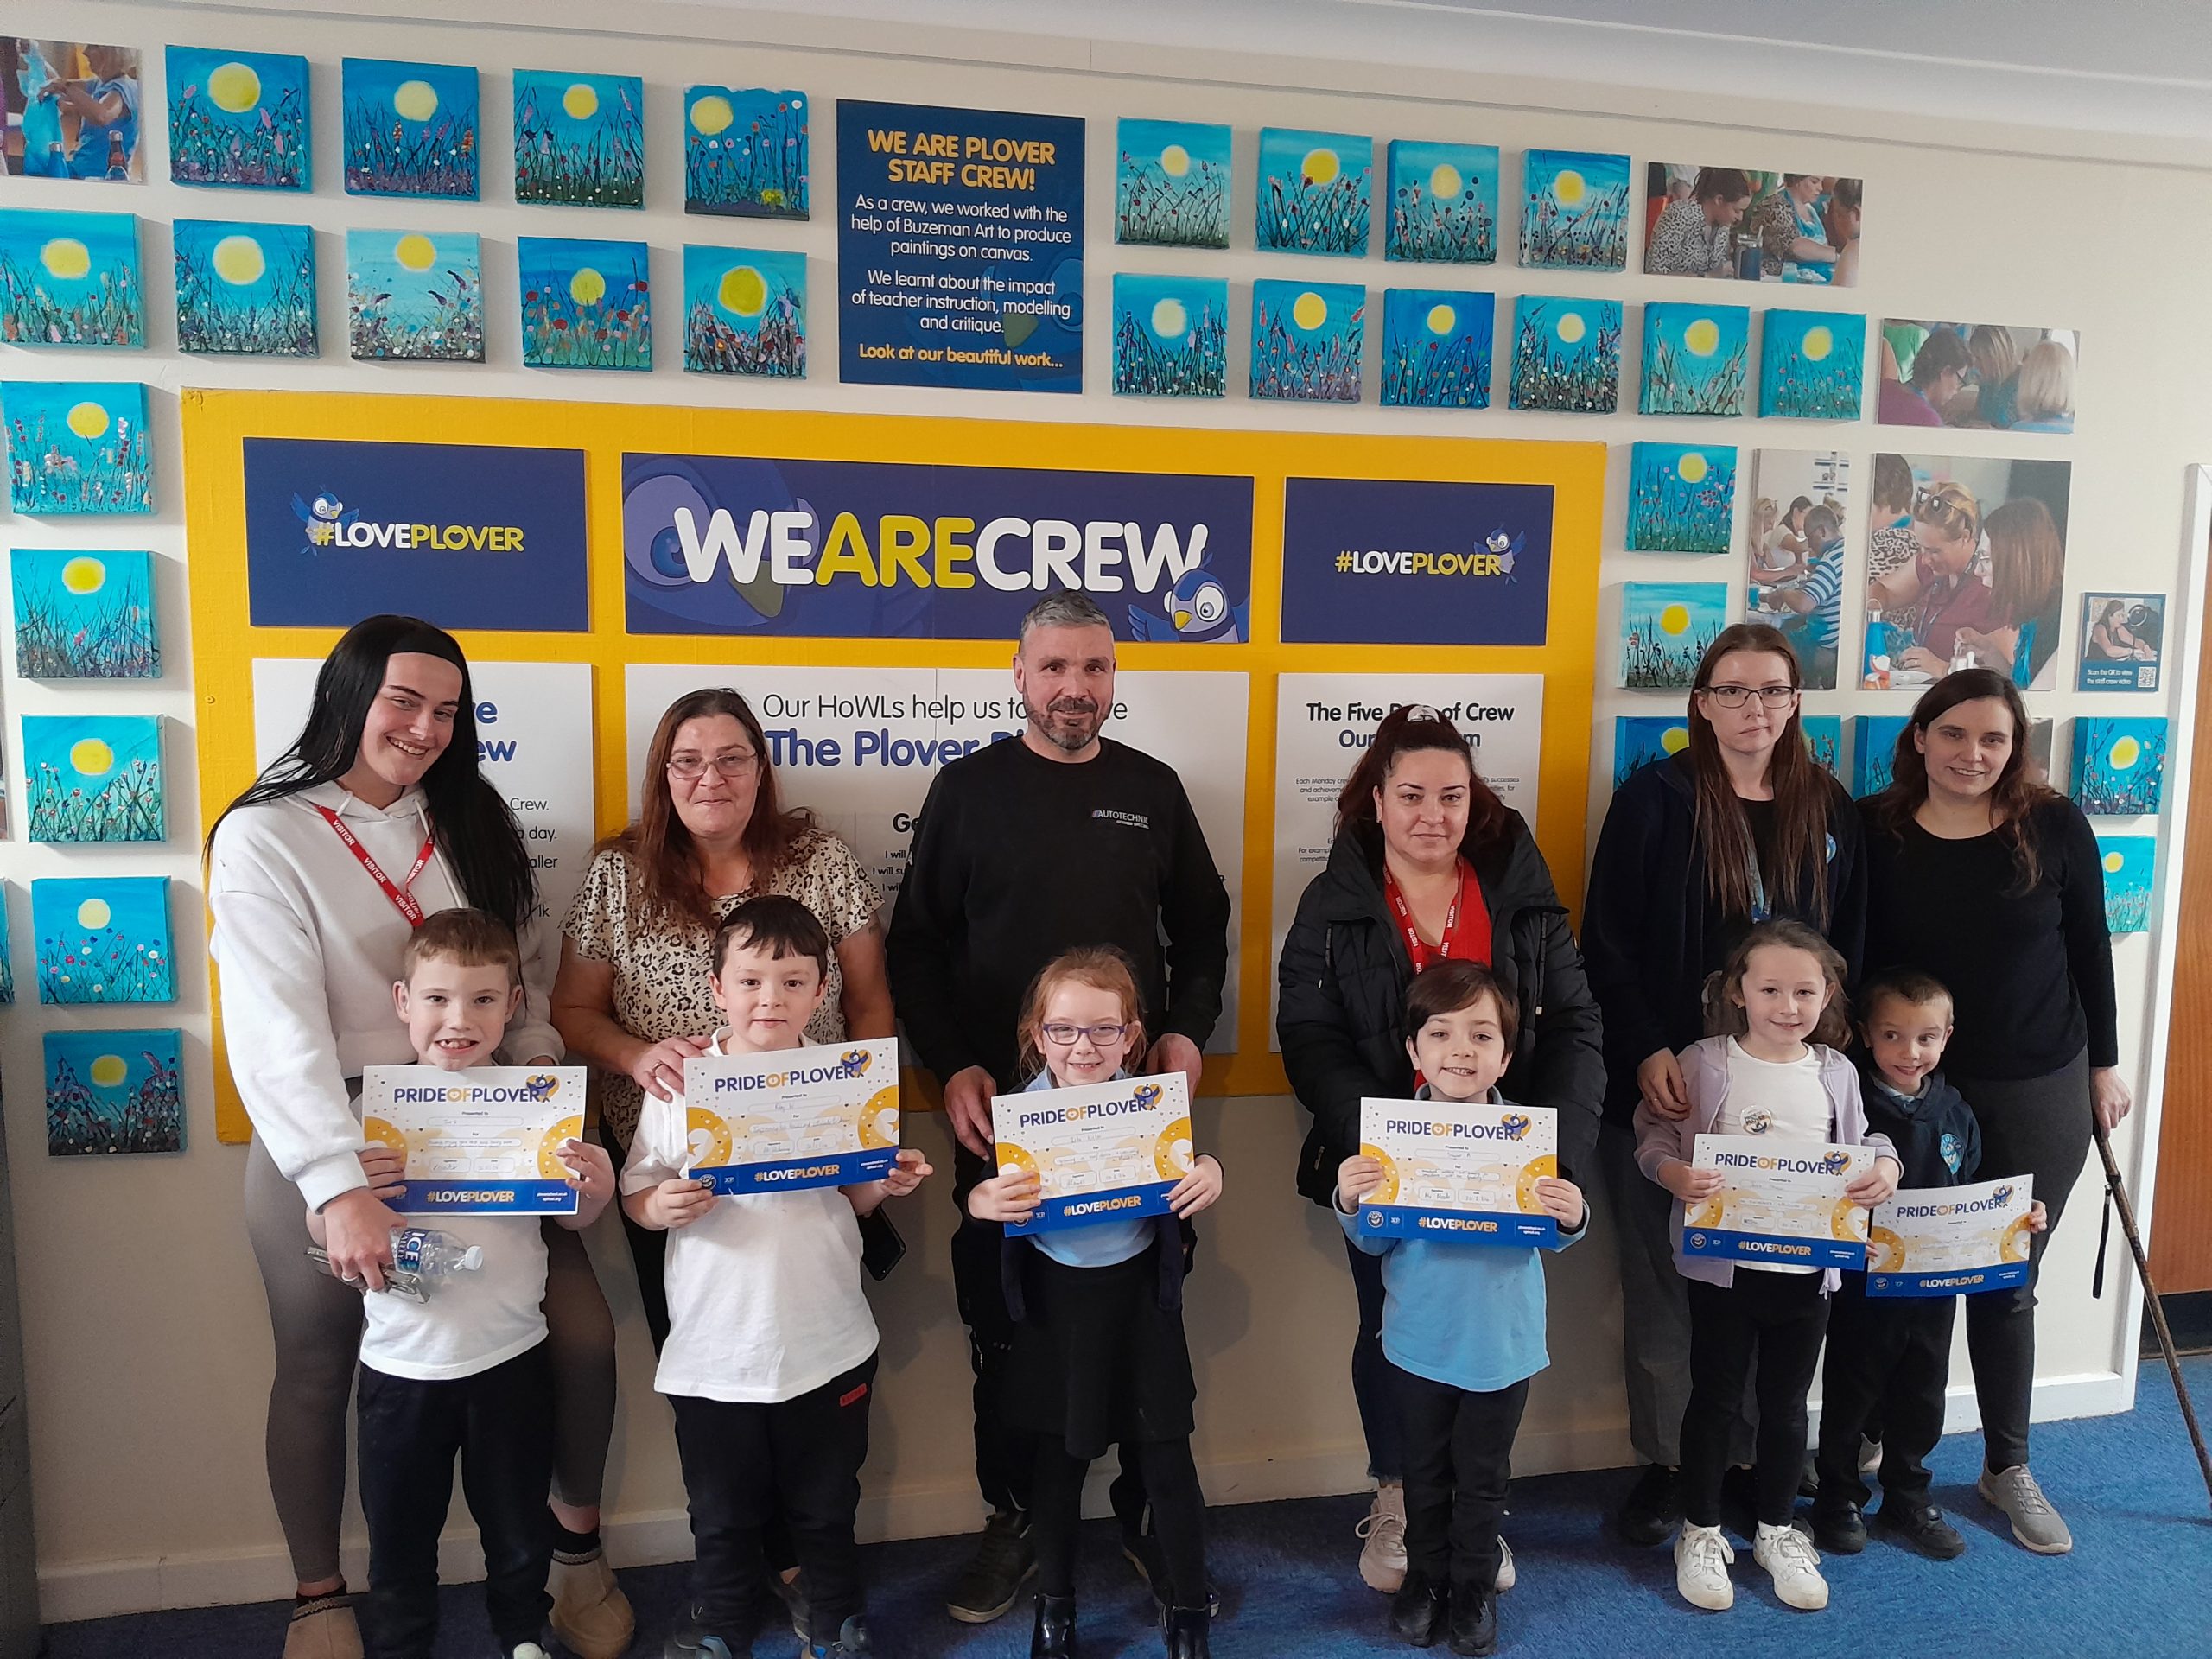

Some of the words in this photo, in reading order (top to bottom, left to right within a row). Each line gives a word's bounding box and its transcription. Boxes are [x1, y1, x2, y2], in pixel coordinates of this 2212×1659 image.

[868, 130, 906, 154] WE
[912, 132, 958, 157] ARE
[965, 137, 1056, 165] PLOVER
[888, 160, 955, 185] STAFF
[961, 165, 1036, 191] CREW!
[855, 194, 874, 209] As
[878, 199, 887, 210] a
[891, 200, 928, 215] crew,
[931, 202, 953, 214] we
[957, 202, 1010, 219] worked
[1013, 206, 1042, 221] with
[1046, 207, 1067, 222] the
[851, 214, 882, 233] help
[886, 217, 900, 232] of
[903, 219, 969, 238] Buzeman
[974, 224, 995, 238] Art
[997, 226, 1010, 239] to
[1014, 226, 1071, 244] produce
[891, 240, 956, 259] paintings
[959, 246, 977, 258] on
[980, 247, 1033, 262] canvas.
[868, 270, 892, 285] We
[895, 271, 935, 288] learnt
[938, 273, 980, 291] about
[982, 276, 1005, 292] the
[1008, 278, 1055, 296] impact
[851, 289, 866, 304] of
[868, 290, 923, 308] teacher
[925, 295, 999, 315] instruction,
[1002, 300, 1071, 319] modelling
[920, 315, 949, 330] and
[951, 317, 1005, 335] critique.
[859, 343, 895, 360] Look
[898, 346, 914, 360] at
[918, 349, 944, 363] our
[946, 346, 1012, 365] beautiful
[1014, 353, 1064, 368] work...
[763, 694, 810, 718] Our
[818, 694, 905, 719] HoWLs
[912, 694, 965, 725] help
[973, 701, 1001, 719] us
[1306, 702, 1342, 721] The
[1347, 702, 1383, 721] Five
[1442, 702, 1461, 721] of
[1466, 703, 1515, 721] Crew
[764, 728, 841, 766] The
[855, 728, 980, 766] Plover
[510, 798, 550, 810] Crew.
[333, 819, 356, 846] VISITOR
[529, 828, 557, 842] day.
[890, 850, 906, 859] will
[364, 857, 386, 882] VISITOR
[877, 867, 893, 875] will
[395, 894, 417, 921] VISITOR
[405, 1232, 426, 1262] ICE
